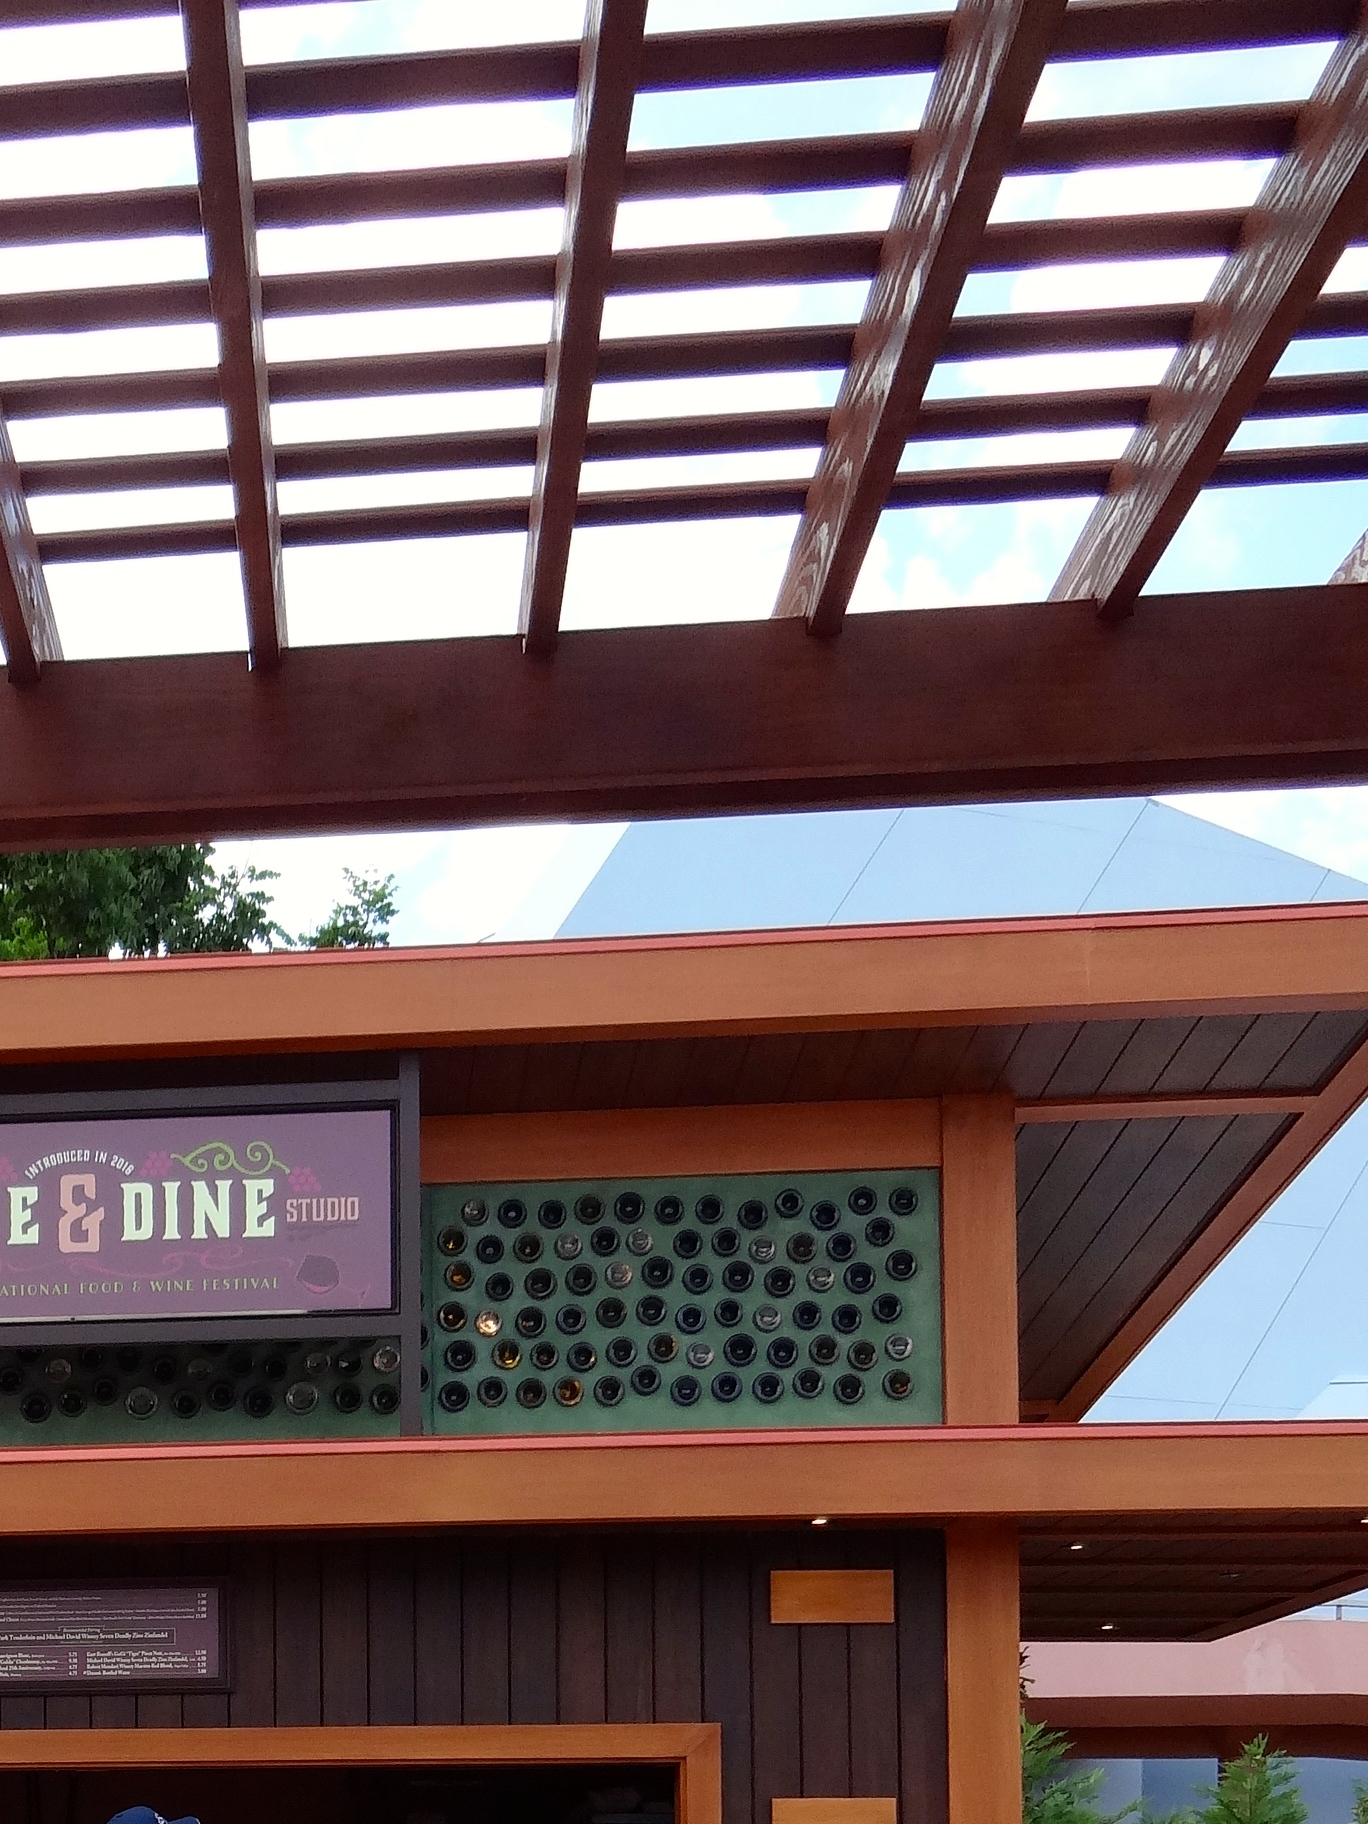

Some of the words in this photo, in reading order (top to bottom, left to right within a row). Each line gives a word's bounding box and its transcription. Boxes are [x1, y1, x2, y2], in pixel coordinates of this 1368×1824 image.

[24, 1149, 90, 1179] INTRODUCED
[94, 1150, 108, 1164] IN
[110, 1154, 135, 1176] 2016
[58, 1174, 105, 1253] &
[120, 1178, 275, 1242] DINE
[286, 1196, 360, 1223] STUDIO
[79, 1281, 124, 1294] FOOD
[149, 1279, 194, 1293] WINE
[202, 1276, 280, 1292] FESTIVAL
